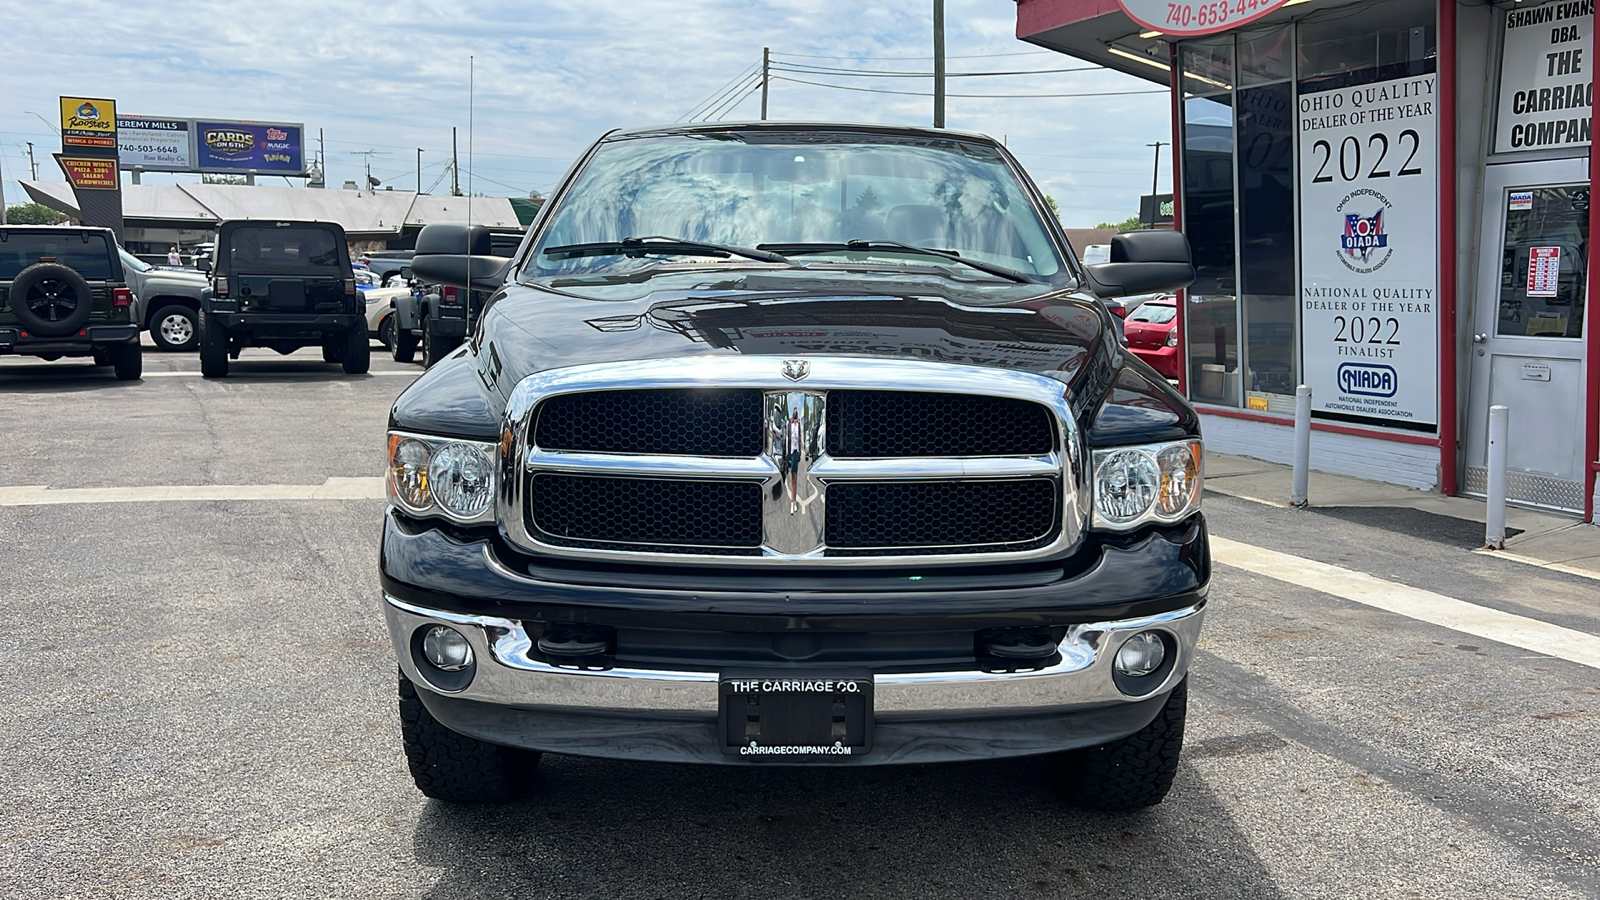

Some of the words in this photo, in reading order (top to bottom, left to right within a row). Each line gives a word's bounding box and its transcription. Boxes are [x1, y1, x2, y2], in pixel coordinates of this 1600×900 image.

[1166, 0, 1269, 26] 740-653-4
[1507, 6, 1553, 29] SHAWN
[1550, 25, 1581, 44] DBA.
[1546, 49, 1582, 77] THE
[1300, 94, 1343, 113] OHIO
[1352, 78, 1435, 107] QUALITY
[1512, 82, 1594, 114] CARRIAG
[68, 117, 110, 129] Roosters
[1303, 114, 1347, 131] DEALER
[1350, 111, 1366, 125] OF
[1370, 107, 1394, 123] THE
[1397, 102, 1432, 119] YEAR
[207, 132, 254, 145] CARDS
[1511, 118, 1593, 148] COMPAN
[118, 144, 178, 153] 740-503-6648
[1312, 129, 1422, 183] 2022
[157, 155, 175, 163] Realty
[1160, 200, 1174, 216] Bes
[1336, 195, 1351, 212] OHIO
[1350, 188, 1393, 209] INDEPENDENT
[1346, 235, 1380, 248] OIADA
[1304, 287, 1367, 298] NATIONAL
[1373, 287, 1433, 300] QUALITY
[1305, 301, 1347, 310] DEALER
[1352, 302, 1366, 311] OF
[1371, 302, 1393, 312] THE
[1399, 303, 1431, 313] YEAR
[1333, 316, 1400, 345] 2022
[1338, 346, 1394, 358] FINALIST
[1342, 369, 1392, 391] NIADA
[1325, 403, 1355, 411] AUTOMOBILE
[1356, 405, 1377, 414] DEALERS
[1378, 407, 1413, 417] ASSOCIATION
[1338, 396, 1362, 404] NATIONAL
[1363, 398, 1398, 408] INDEPENDENT
[731, 681, 759, 692] THE
[762, 681, 834, 692] CARRIAGE
[837, 681, 860, 693] CO.
[740, 746, 852, 755] CARRIAGECOMPANY.COM
